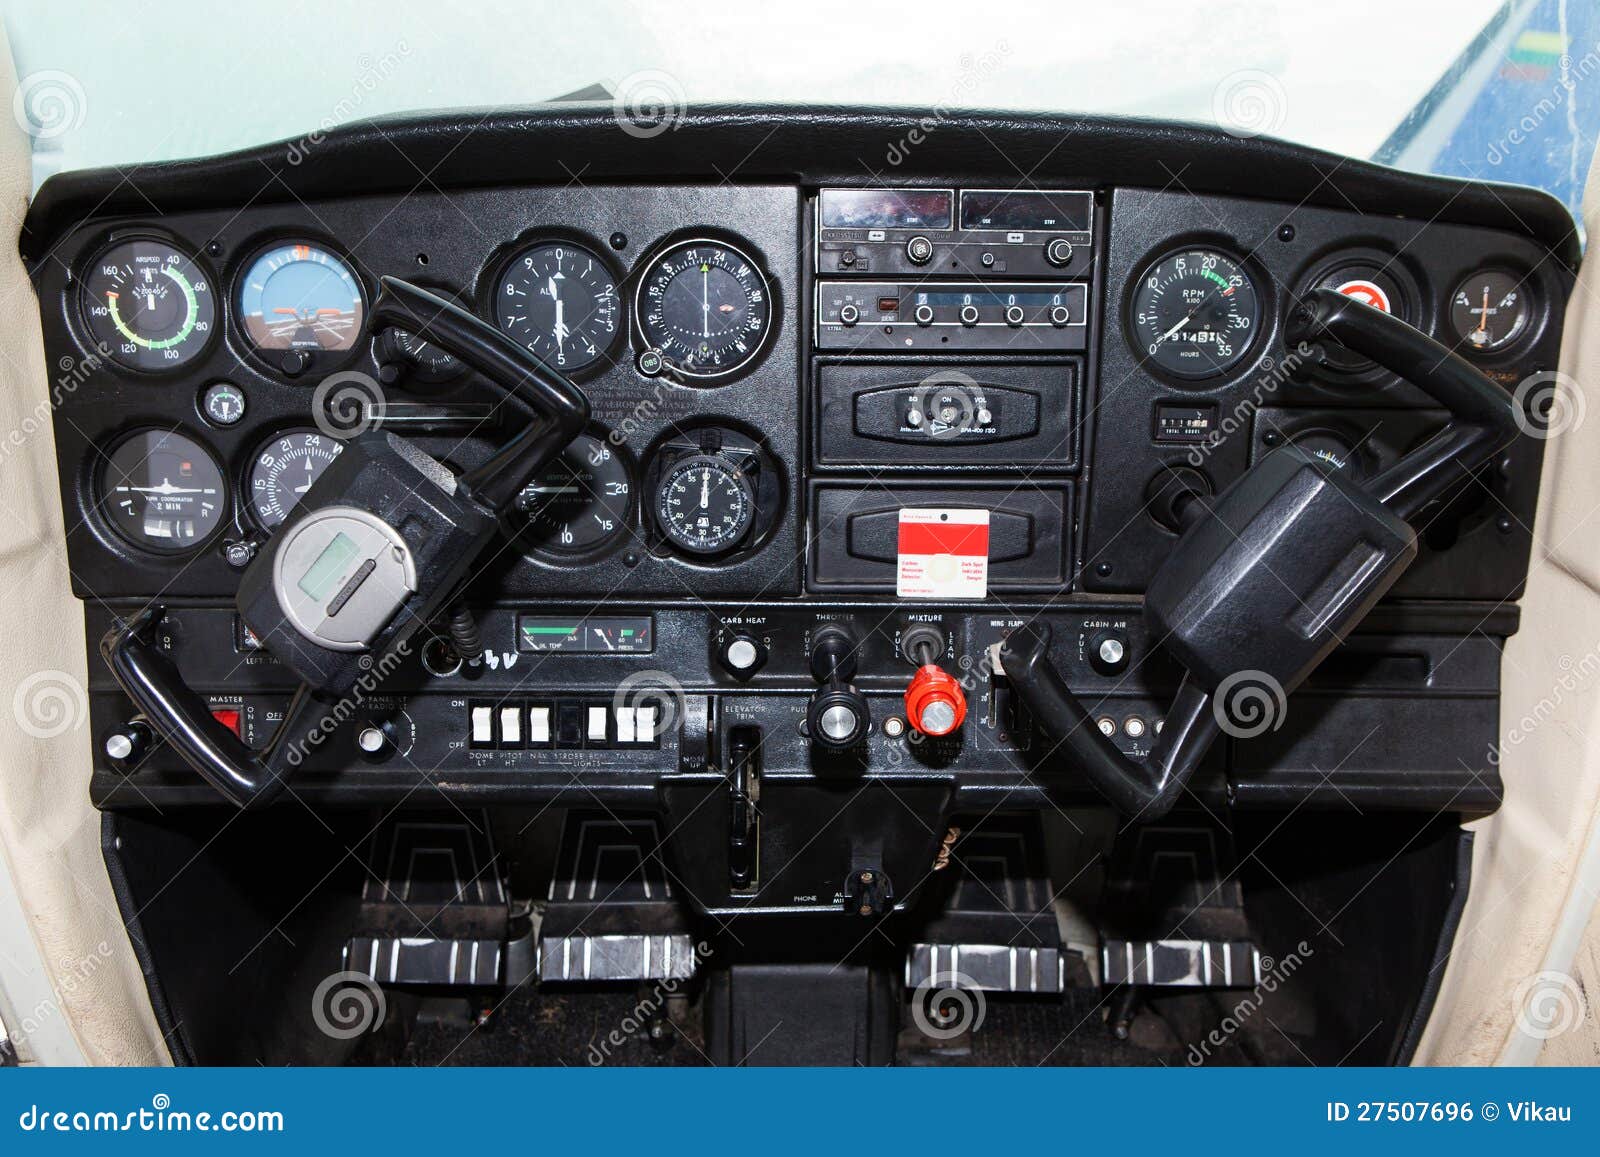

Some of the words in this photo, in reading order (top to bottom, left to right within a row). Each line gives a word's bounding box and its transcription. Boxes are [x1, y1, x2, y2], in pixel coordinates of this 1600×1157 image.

[556, 248, 563, 260] 0
[686, 250, 698, 260] 21
[714, 250, 726, 262] 24
[167, 256, 180, 264] 40
[524, 258, 532, 270] 9
[1176, 258, 1186, 270] 15
[1202, 258, 1216, 269] 20
[102, 266, 118, 276] 160
[662, 262, 674, 274] S
[738, 264, 750, 277] W
[1148, 278, 1158, 289] 10
[1229, 275, 1243, 287] 25
[194, 282, 206, 292] 60
[506, 284, 514, 296] 8
[605, 284, 614, 296] 2
[648, 286, 660, 297] 15
[752, 290, 762, 302] 30
[1182, 290, 1205, 298] RPM
[964, 294, 971, 306] 0
[1008, 294, 1016, 306] 0
[1054, 294, 1060, 306] 0
[92, 306, 108, 316] 140
[508, 316, 515, 328] 7
[648, 314, 660, 326] 12
[750, 318, 761, 330] 33
[1138, 314, 1146, 324] 5
[1235, 318, 1250, 329] 30
[196, 322, 208, 331] 80
[606, 320, 614, 332] 3
[121, 344, 136, 353] 120
[662, 336, 675, 350] E
[735, 338, 748, 353] N
[164, 350, 178, 359] 100
[586, 344, 596, 356] 4
[1149, 344, 1156, 354] 0
[1218, 345, 1232, 356] 35
[558, 354, 566, 364] 5
[644, 357, 658, 368] OBS
[280, 439, 293, 452] 21
[305, 435, 320, 446] 24
[600, 450, 610, 460] 15
[261, 454, 275, 468] S
[254, 479, 266, 490] 15
[615, 484, 628, 494] 20
[128, 506, 135, 516] L
[166, 503, 181, 511] MIN
[260, 504, 273, 516] 12
[202, 508, 208, 518] R
[602, 520, 614, 530] 15
[562, 532, 573, 544] 10
[163, 636, 171, 650] ON
